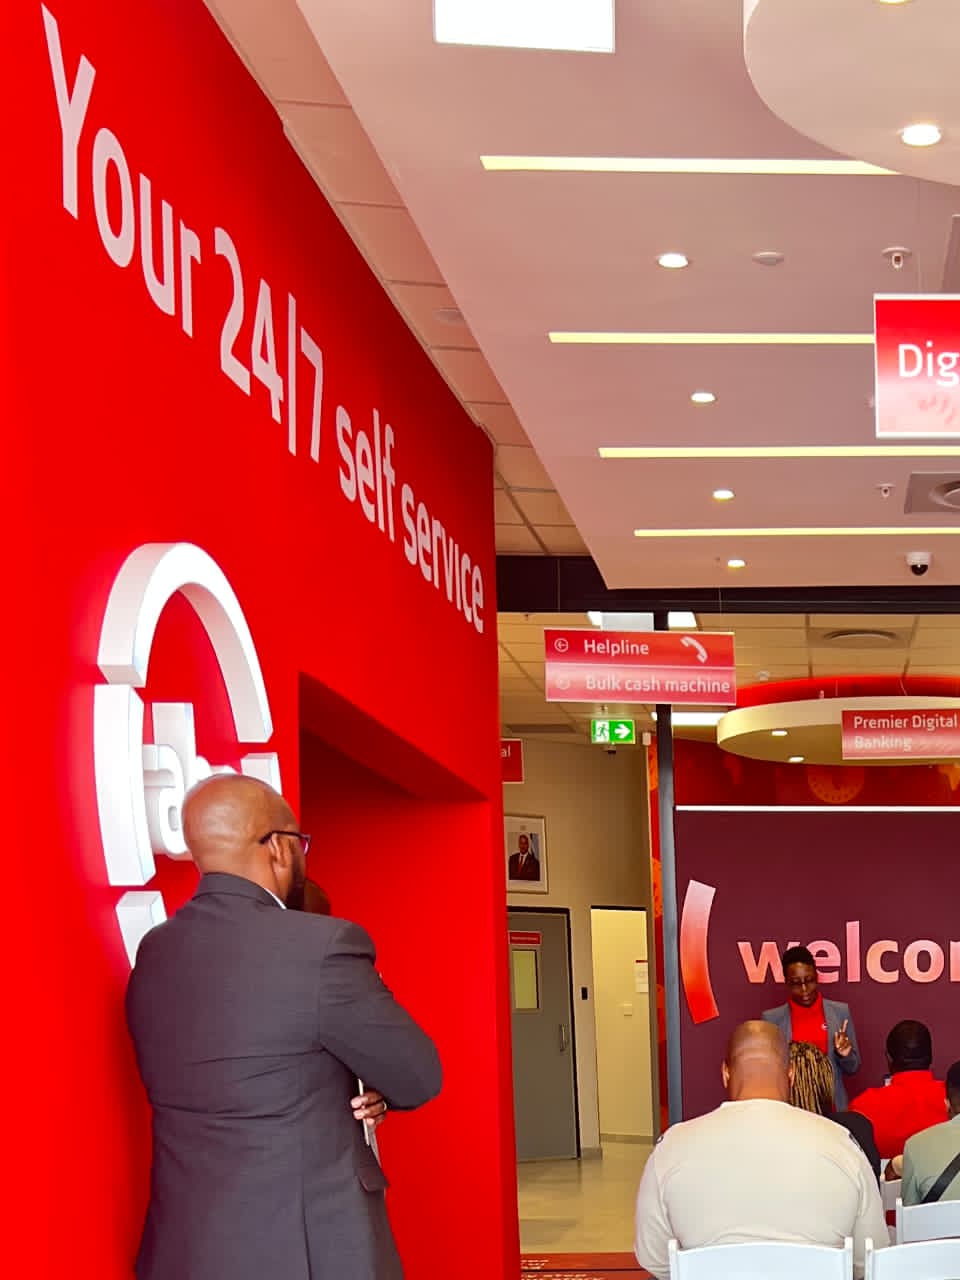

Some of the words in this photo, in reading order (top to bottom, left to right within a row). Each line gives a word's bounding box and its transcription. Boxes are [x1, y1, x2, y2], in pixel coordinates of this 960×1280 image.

[41, 3, 201, 337] Your
[335, 404, 396, 543] self
[401, 483, 484, 634] service
[584, 639, 649, 656] Helpline
[586, 674, 622, 690] Bulk
[624, 675, 661, 691] cash
[665, 676, 731, 693] machine
[853, 714, 908, 729] Premier
[911, 713, 958, 732] Digital
[854, 735, 913, 751] Banking
